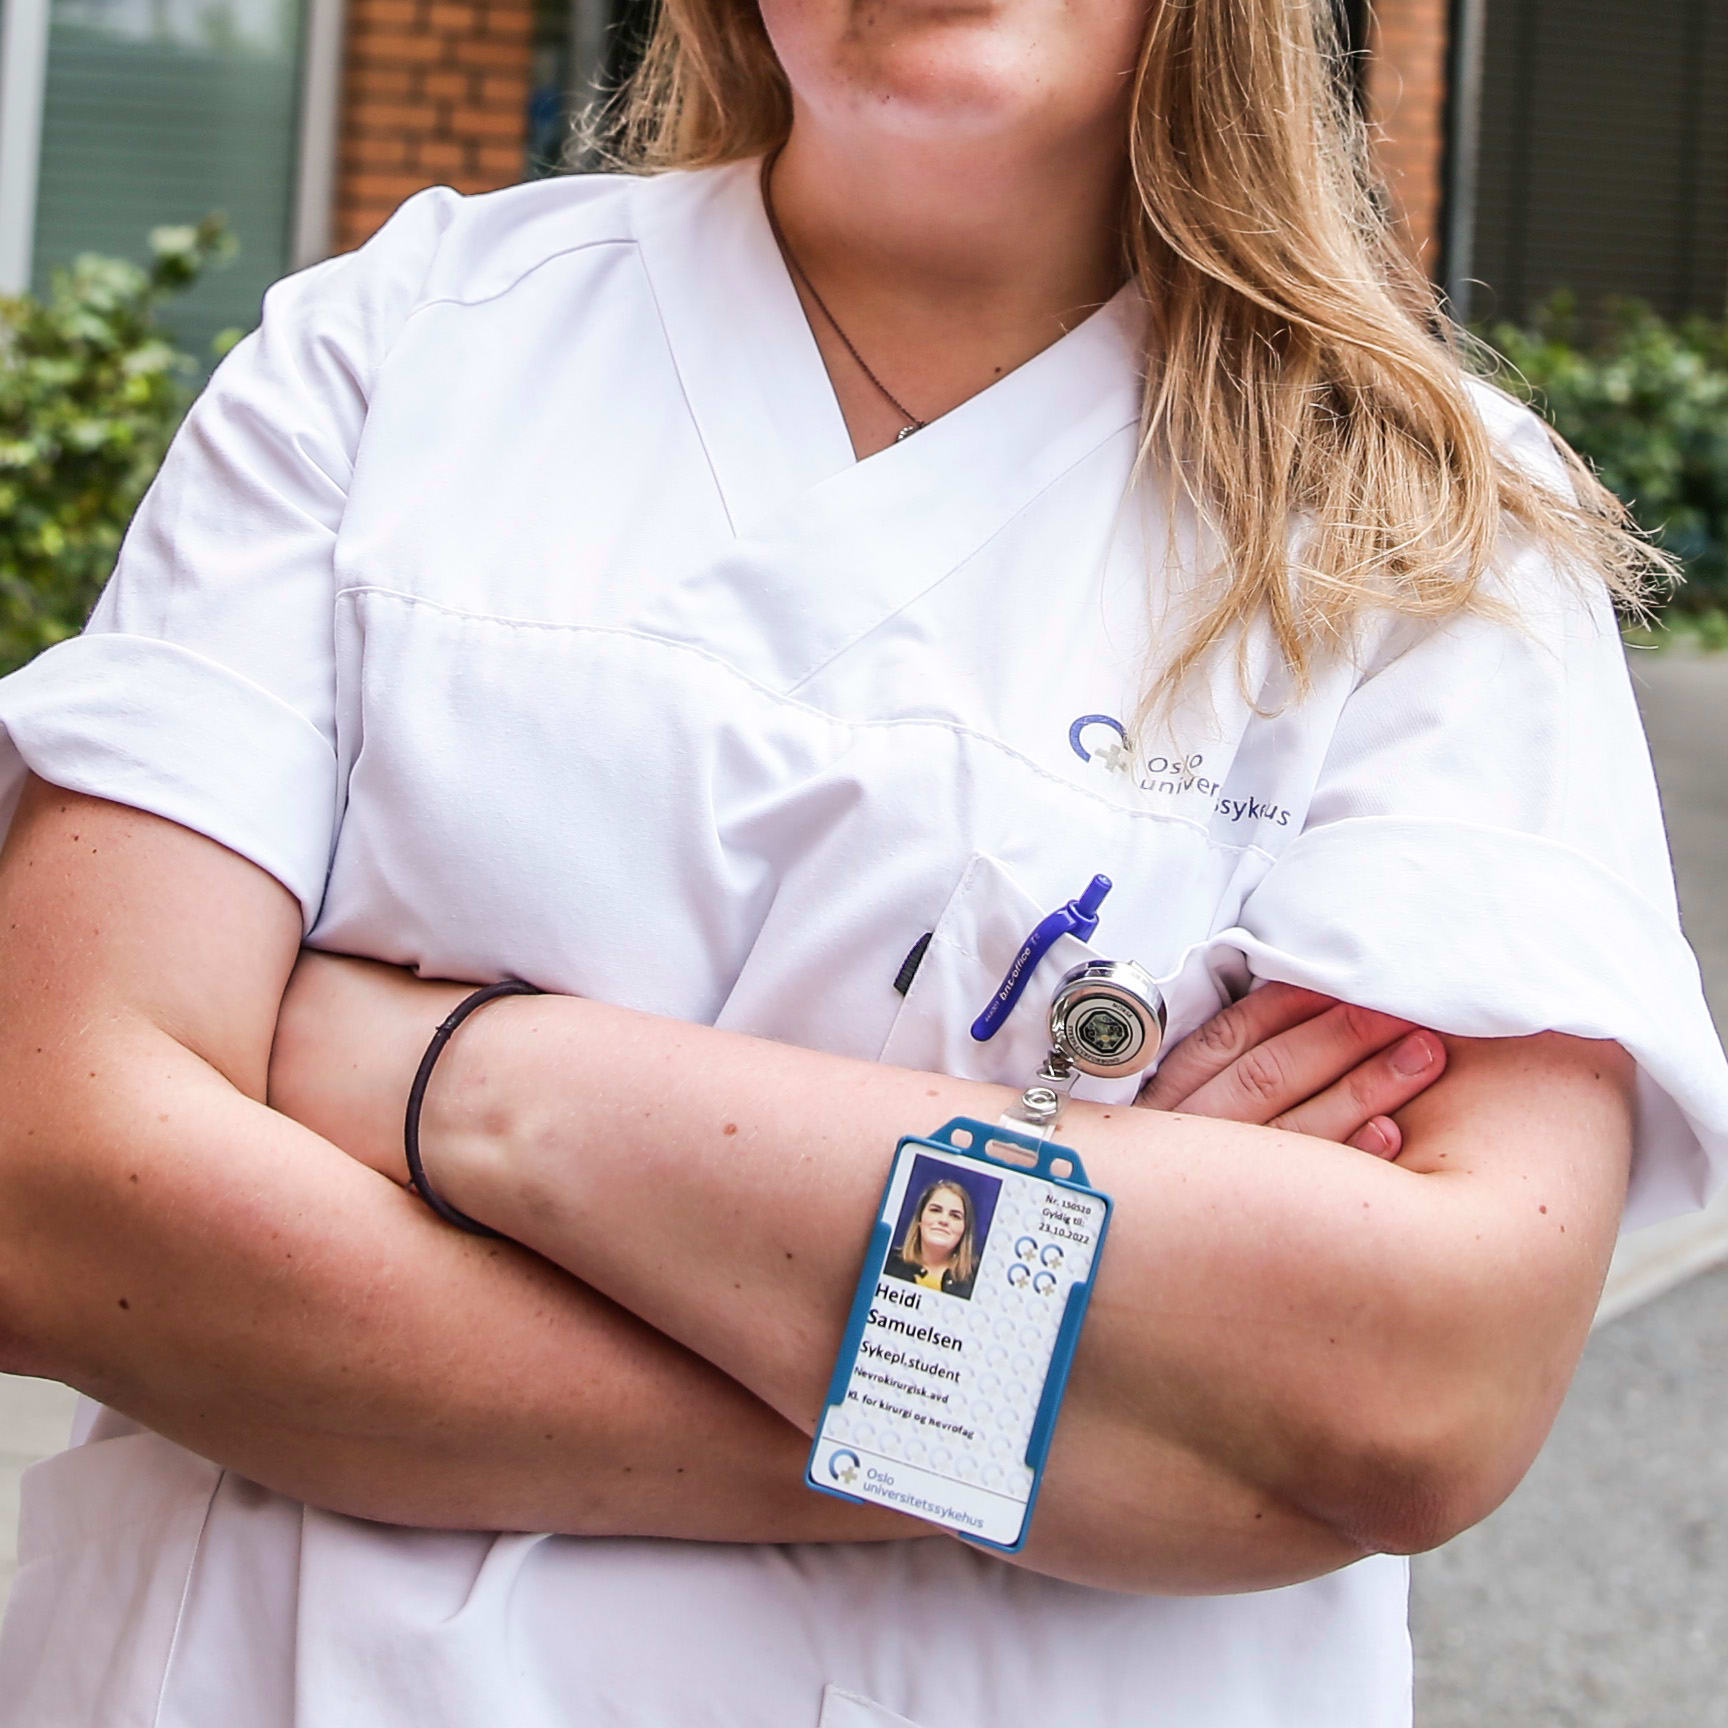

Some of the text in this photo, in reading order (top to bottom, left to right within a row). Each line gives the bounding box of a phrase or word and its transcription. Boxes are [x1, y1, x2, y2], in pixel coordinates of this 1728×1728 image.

[1148, 754, 1203, 774] Oslo
[1042, 1207, 1070, 1225] Gyldig
[875, 1282, 922, 1310] Heidi
[867, 1308, 963, 1352] Samuelsen
[860, 1340, 961, 1383] Sykepl.student
[863, 1394, 877, 1405] for
[879, 1399, 912, 1419] kirurgi
[914, 1413, 927, 1424] og
[866, 1468, 895, 1486] Oslo
[863, 1481, 984, 1529] universitetssykehus
